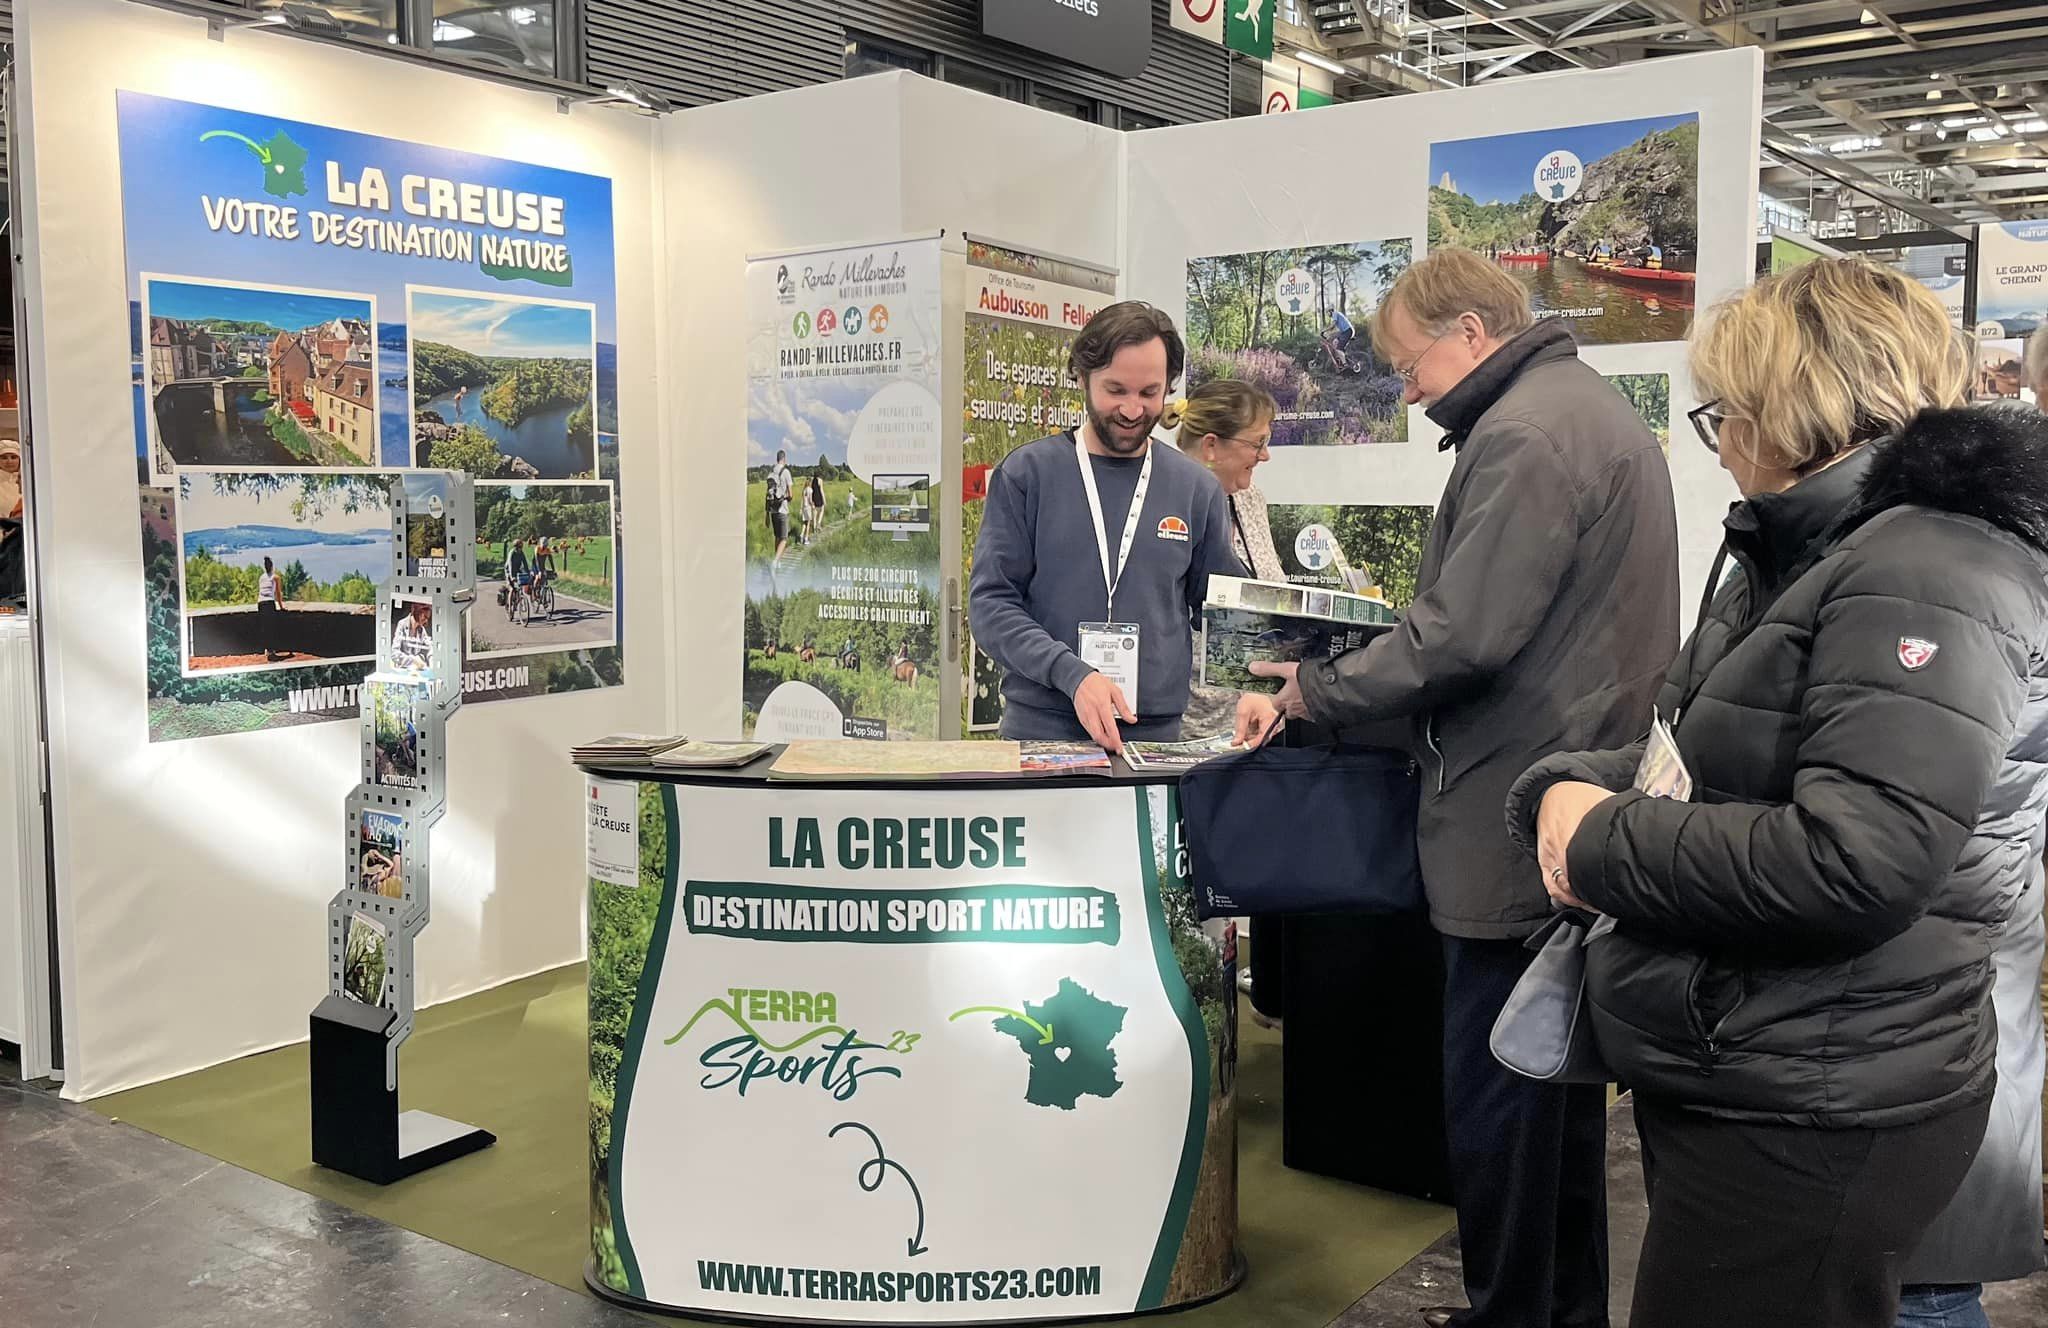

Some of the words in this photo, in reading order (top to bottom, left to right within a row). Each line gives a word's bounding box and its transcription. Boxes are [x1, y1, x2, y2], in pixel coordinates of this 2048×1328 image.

[326, 160, 390, 211] LA
[401, 174, 566, 237] CREUSE
[201, 195, 300, 241] VOTRE
[308, 210, 473, 264] DESTINATION
[480, 233, 569, 274] NATURE
[801, 261, 836, 291] Rando
[839, 251, 906, 286] Millevaches
[1996, 267, 2008, 275] LE
[2009, 264, 2048, 275] GRAND
[1999, 275, 2042, 285] CHEMIN
[979, 286, 1049, 321] Aubusson
[780, 341, 902, 367] RANDO-MILLEVACHES.FR
[986, 350, 1007, 381] Des
[1011, 359, 1058, 390] espaces
[970, 397, 1027, 429] sauvages
[1031, 396, 1043, 425] et
[1048, 398, 1088, 428] authent
[1157, 531, 1189, 542] ellesse
[831, 566, 851, 580] PLUS
[853, 566, 862, 581] DE
[864, 567, 879, 582] 200
[881, 568, 918, 585] CIRCUITS
[831, 584, 863, 601] DÉCRITS
[865, 586, 874, 602] ET
[876, 587, 918, 604] ILLUSTRÉS
[818, 604, 869, 621] ACCESSIBLES
[870, 607, 931, 625] GRATUITEMENT
[852, 725, 867, 737] App
[867, 726, 884, 738] Store
[380, 773, 411, 787] ACTIVITÉS
[600, 818, 631, 833] CREUSE
[768, 816, 825, 870] LA
[837, 816, 1027, 871] CREUSE
[693, 894, 880, 933] DESTINATION
[887, 898, 986, 933] SPORT
[992, 896, 1105, 932] NATURE
[728, 988, 837, 1024] TERRA
[700, 1029, 901, 1101] Sports
[887, 1030, 922, 1054] 23
[697, 1260, 1102, 1303] WWW.TERRASPORTS23.COM
